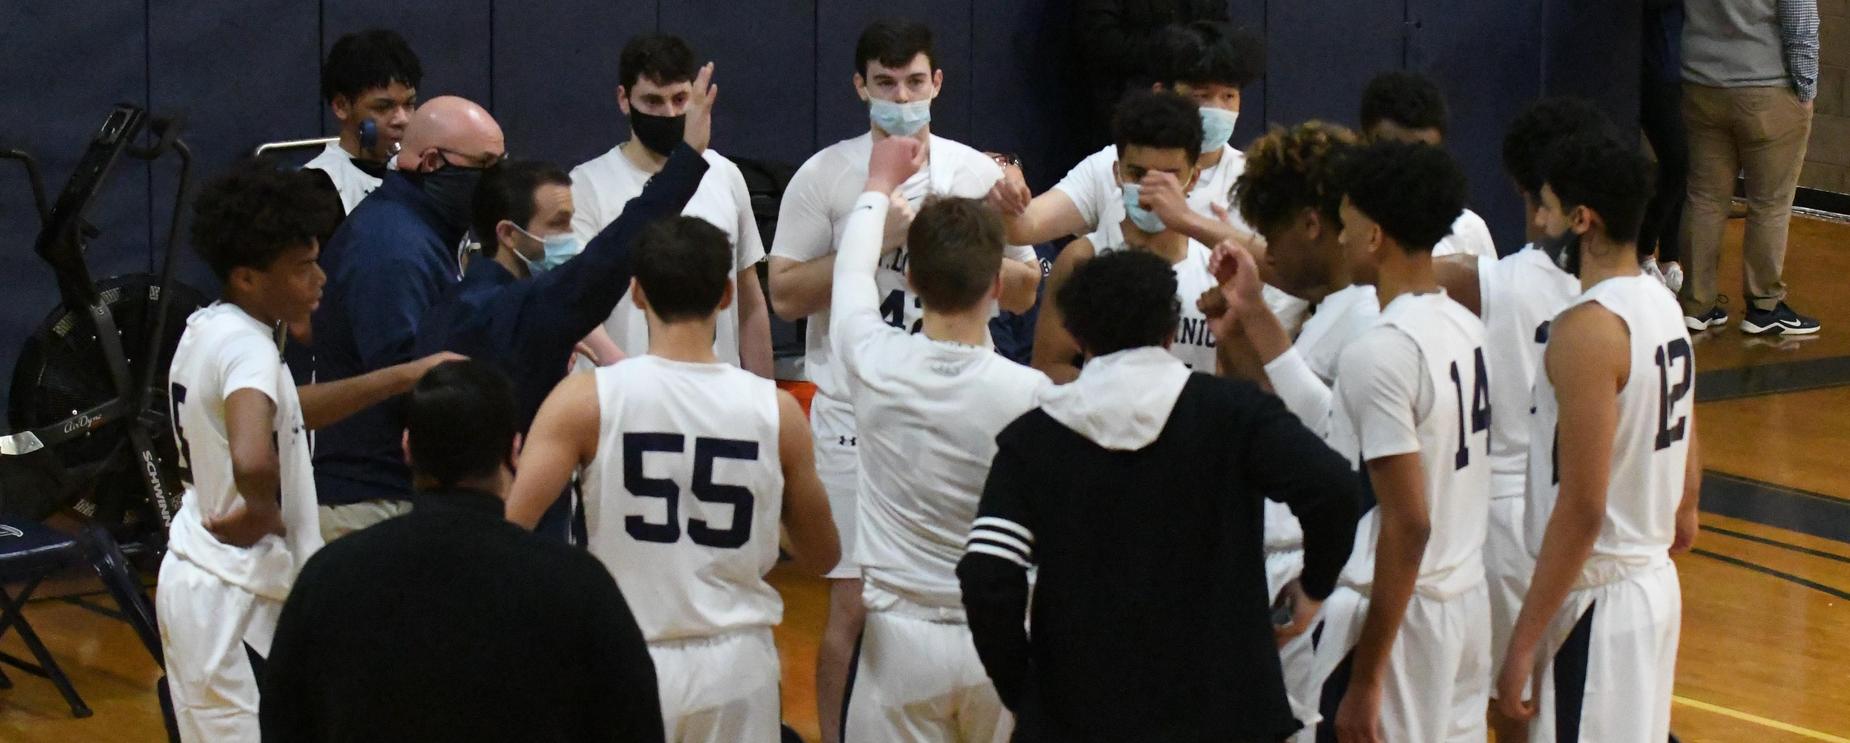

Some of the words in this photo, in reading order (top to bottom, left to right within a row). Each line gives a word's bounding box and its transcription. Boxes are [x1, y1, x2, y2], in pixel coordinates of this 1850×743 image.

[1450, 347, 1491, 470] 14
[1655, 337, 1693, 451] 12
[142, 450, 172, 527] SCHWINN
[623, 432, 759, 549] 55
